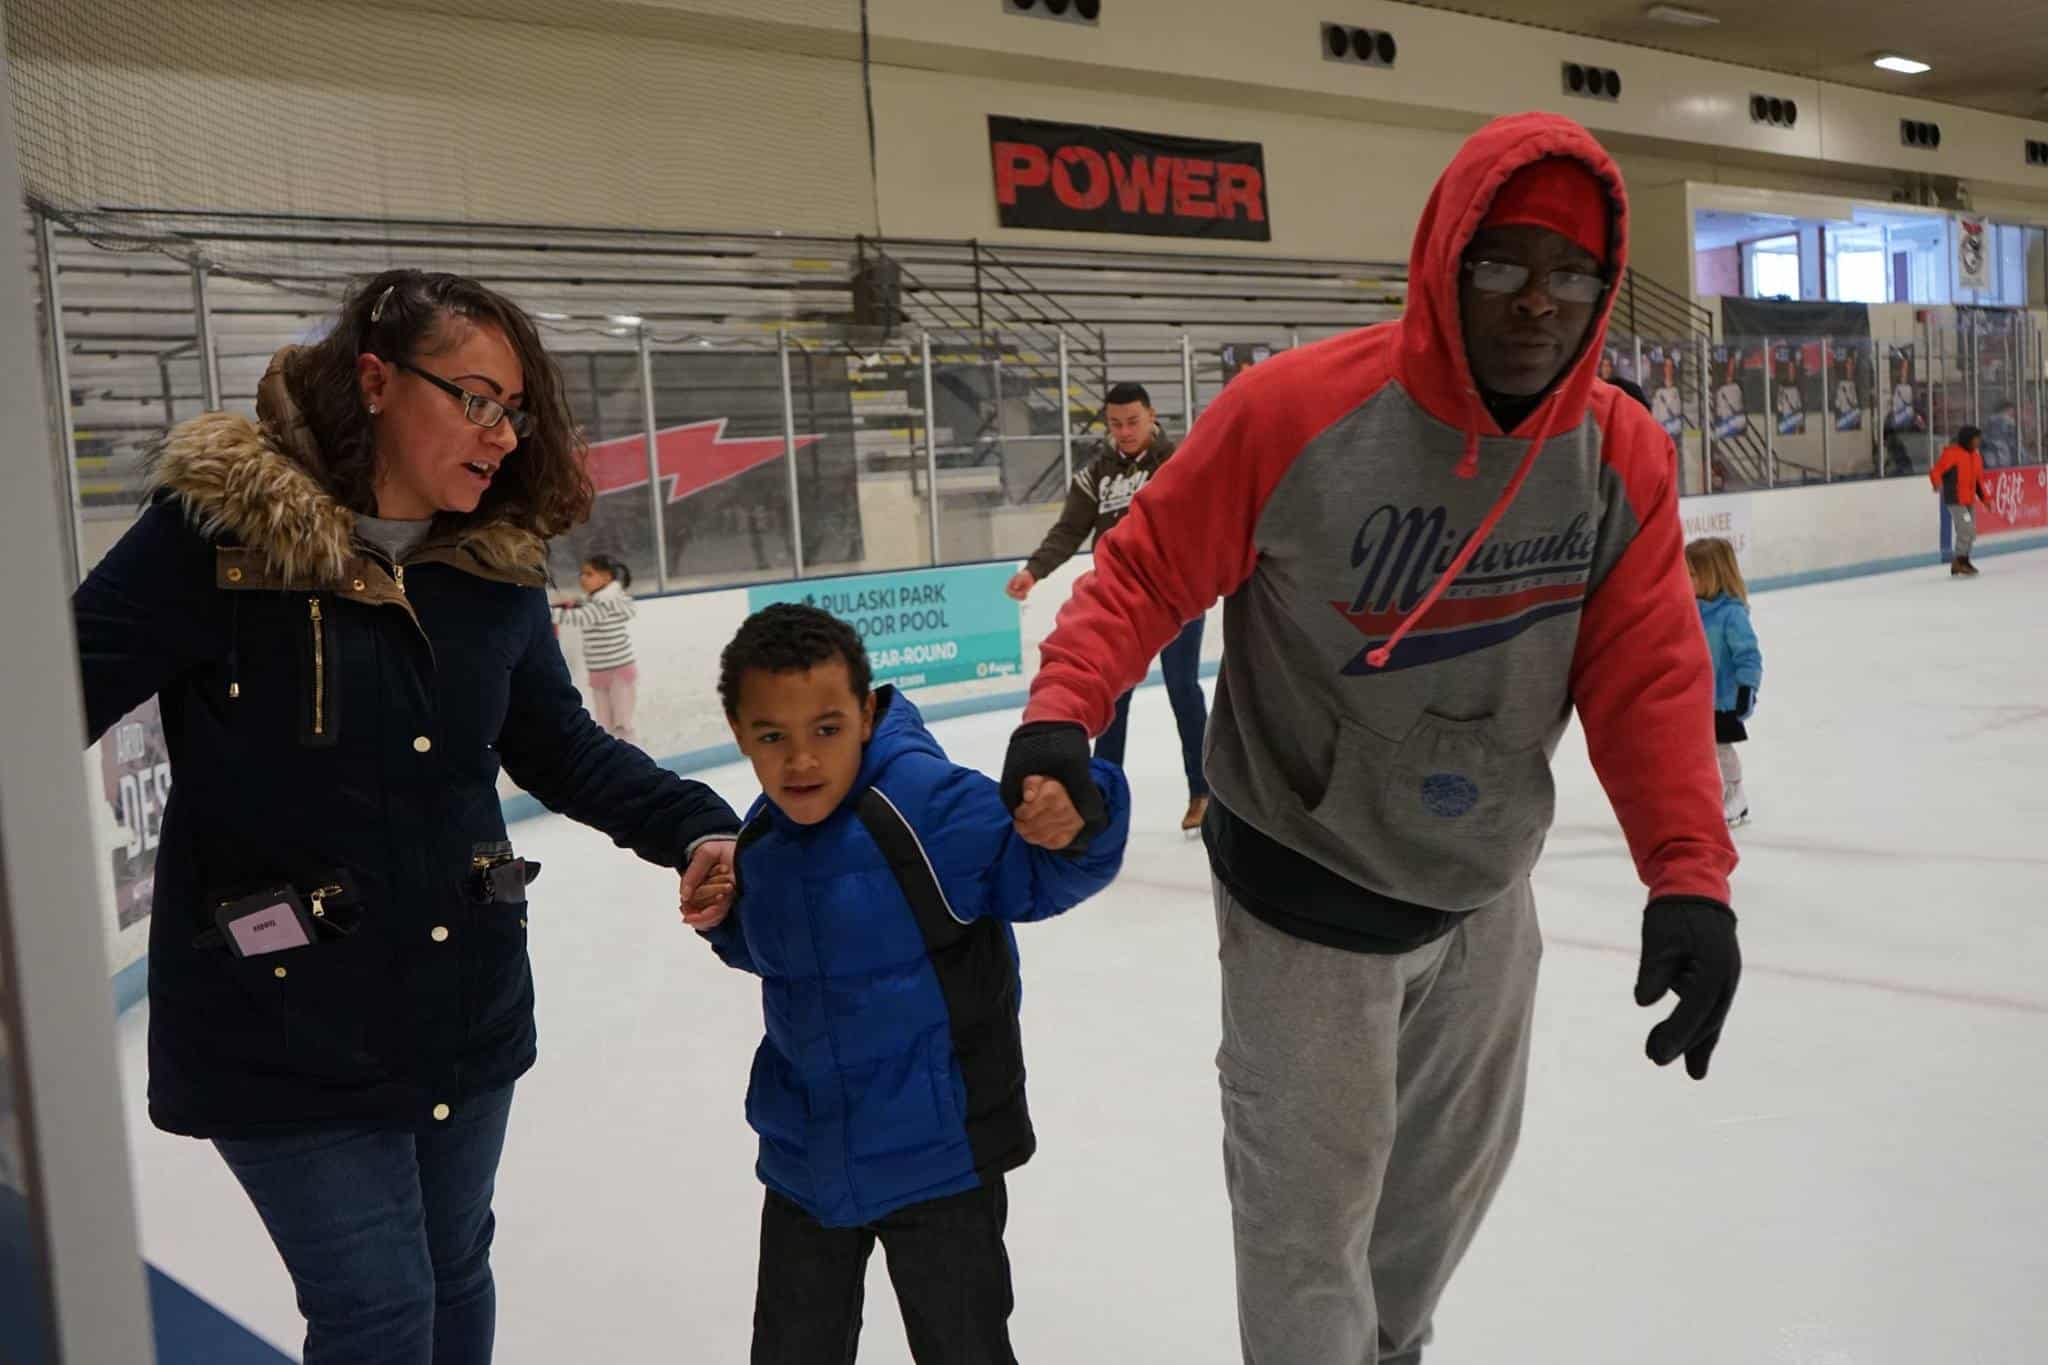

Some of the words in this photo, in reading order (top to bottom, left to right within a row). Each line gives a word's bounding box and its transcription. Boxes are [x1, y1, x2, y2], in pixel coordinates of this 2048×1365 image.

[991, 141, 1265, 222] POWER
[822, 588, 896, 614] PULASKI
[899, 583, 947, 606] PARK
[853, 613, 896, 637] OOR
[899, 609, 949, 632] POOL
[868, 641, 958, 670] EAR-ROUND
